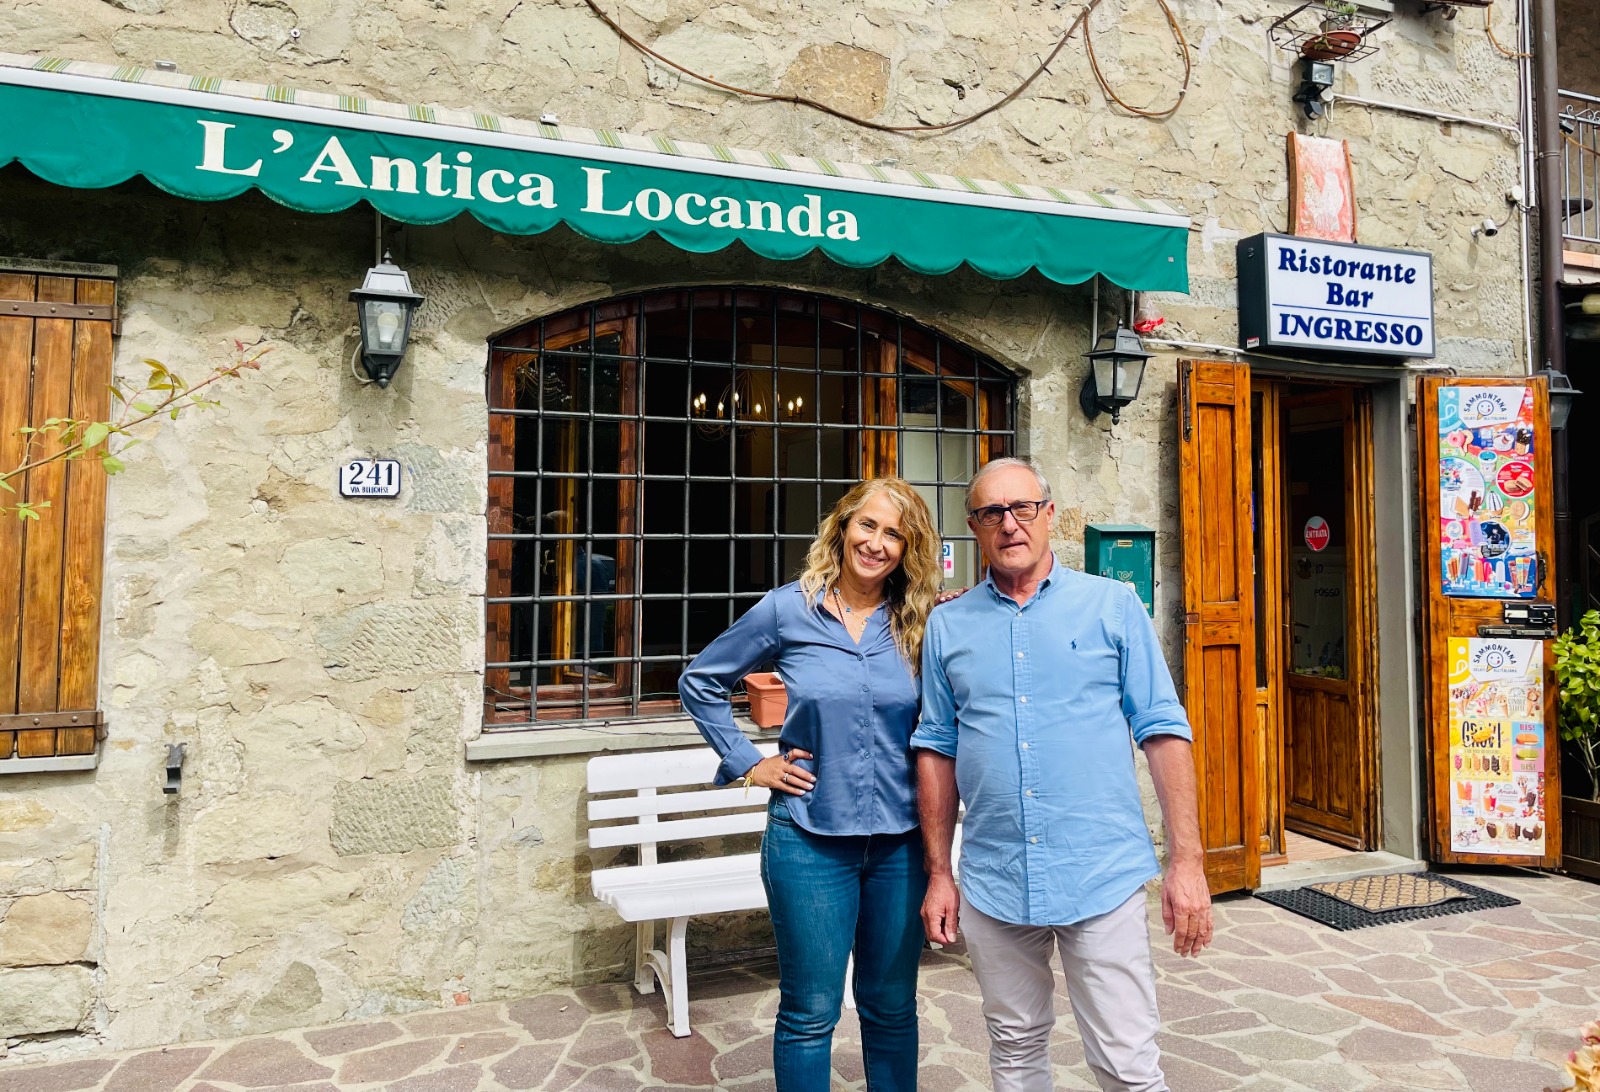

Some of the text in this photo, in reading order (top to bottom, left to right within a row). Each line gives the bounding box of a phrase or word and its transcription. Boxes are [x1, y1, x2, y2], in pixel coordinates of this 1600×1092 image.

[195, 120, 860, 241] L'Antica Locanda
[1278, 247, 1416, 284] Ristorante
[1326, 282, 1374, 308] Bar
[1278, 313, 1423, 346] INGRESSO
[1463, 392, 1507, 412] SAMMONTANA
[349, 462, 393, 486] 241
[1306, 529, 1327, 538] ENTRATA
[1473, 643, 1517, 665] SAMMONTANA
[1520, 763, 1536, 771] BIS!
